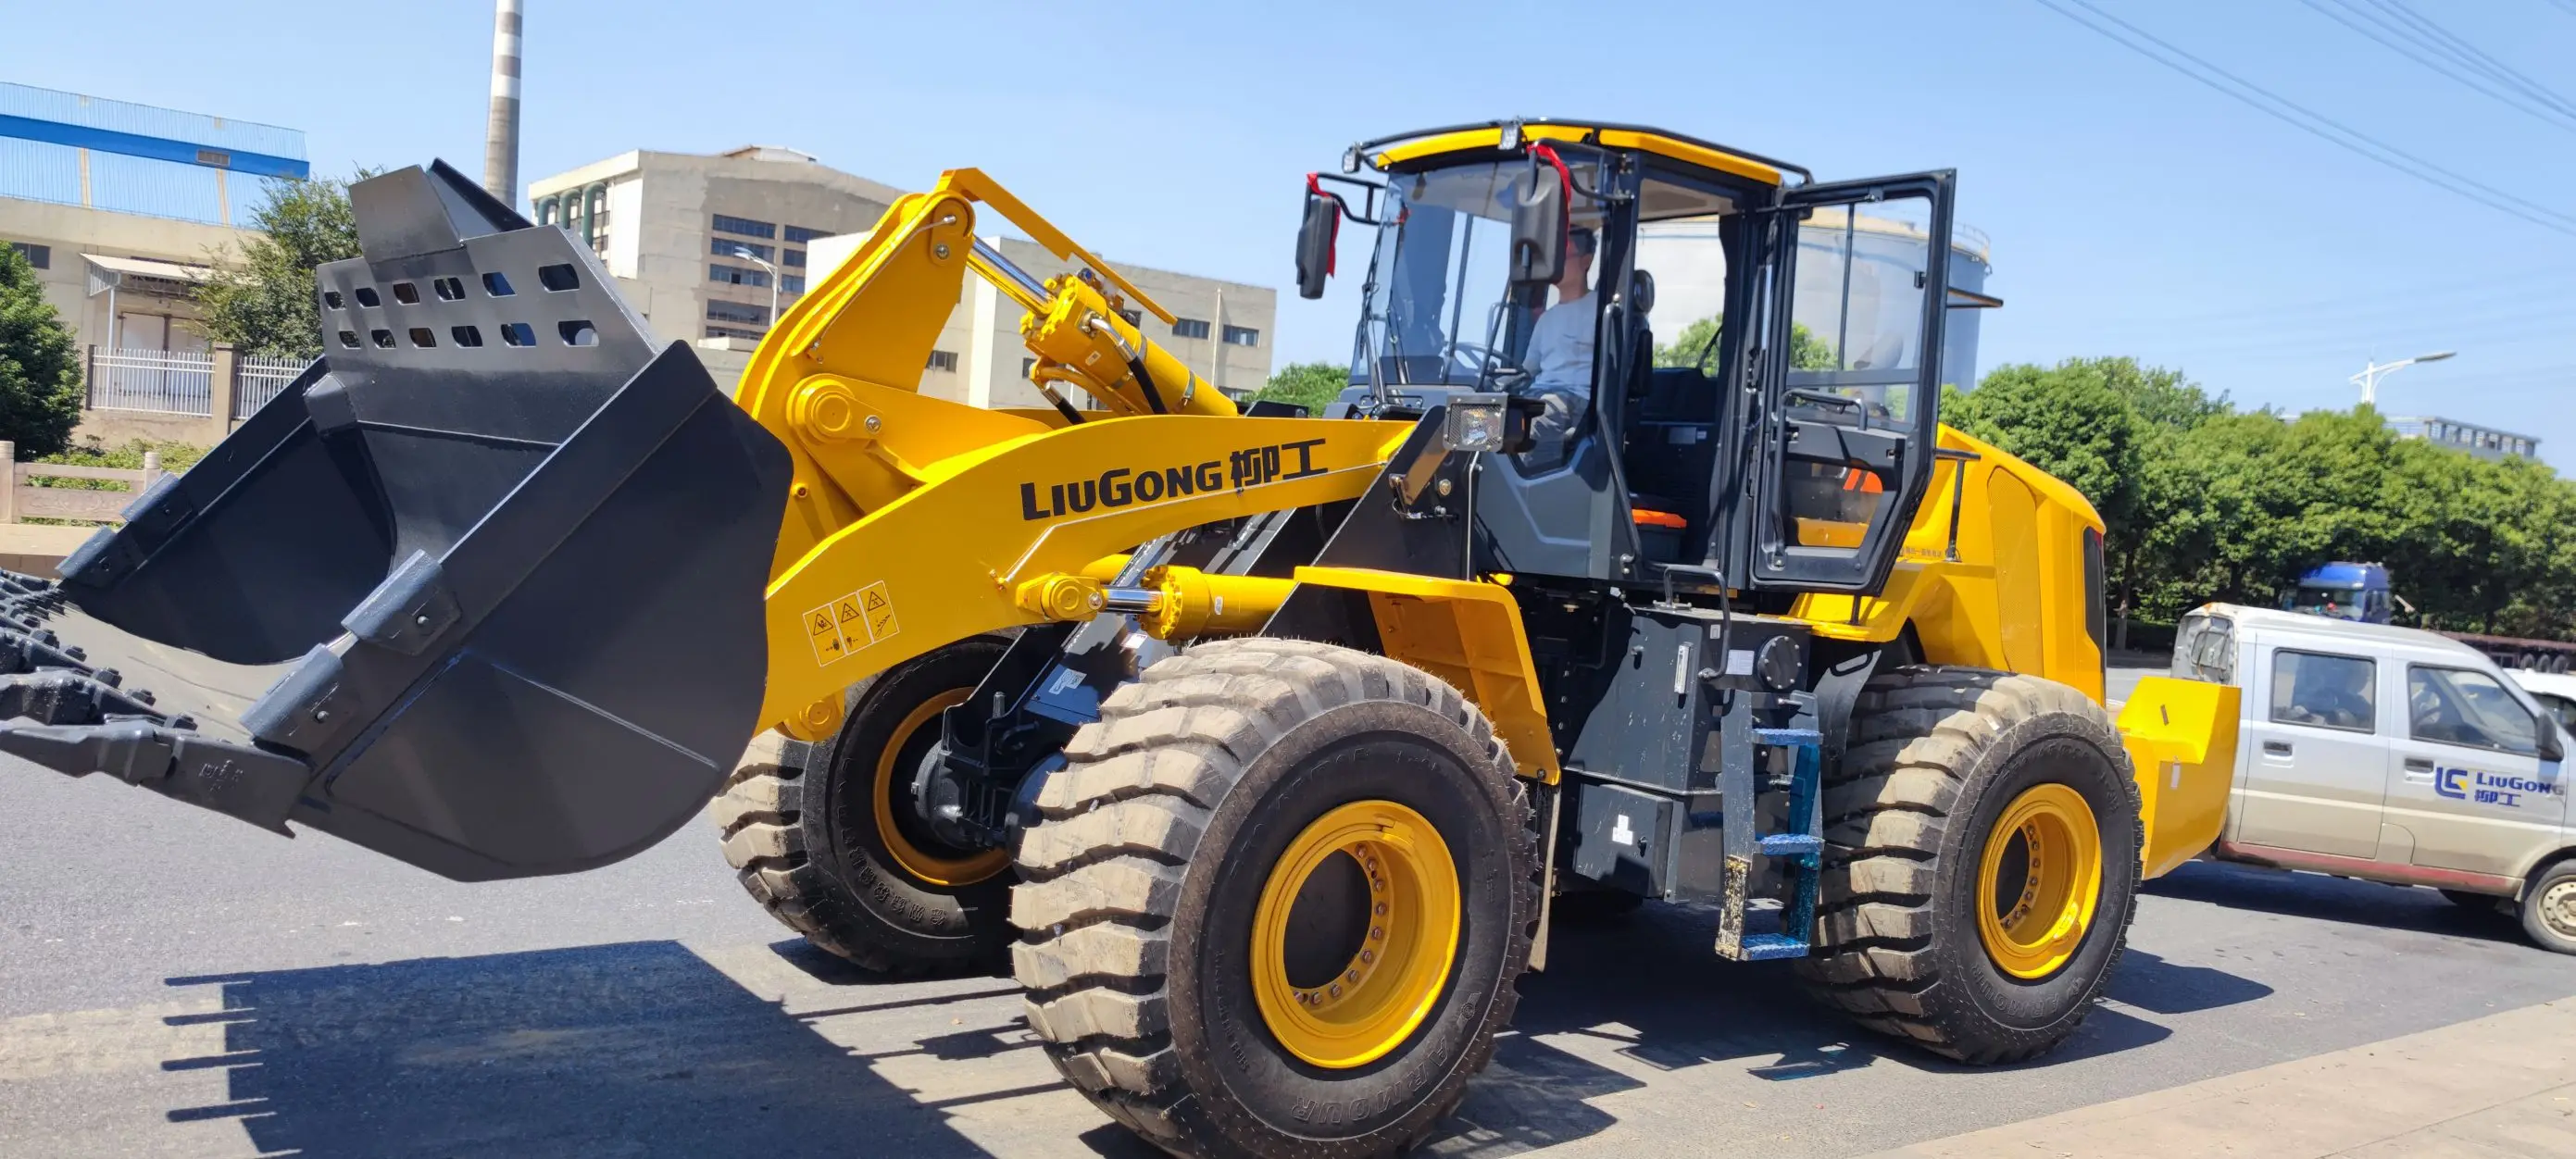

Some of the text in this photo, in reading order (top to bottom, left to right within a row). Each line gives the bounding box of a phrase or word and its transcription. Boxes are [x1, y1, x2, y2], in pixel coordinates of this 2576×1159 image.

[1230, 438, 1329, 492] 柳工
[2474, 790, 2522, 807] 柳工
[1291, 1037, 1449, 1124] ARMOUR
